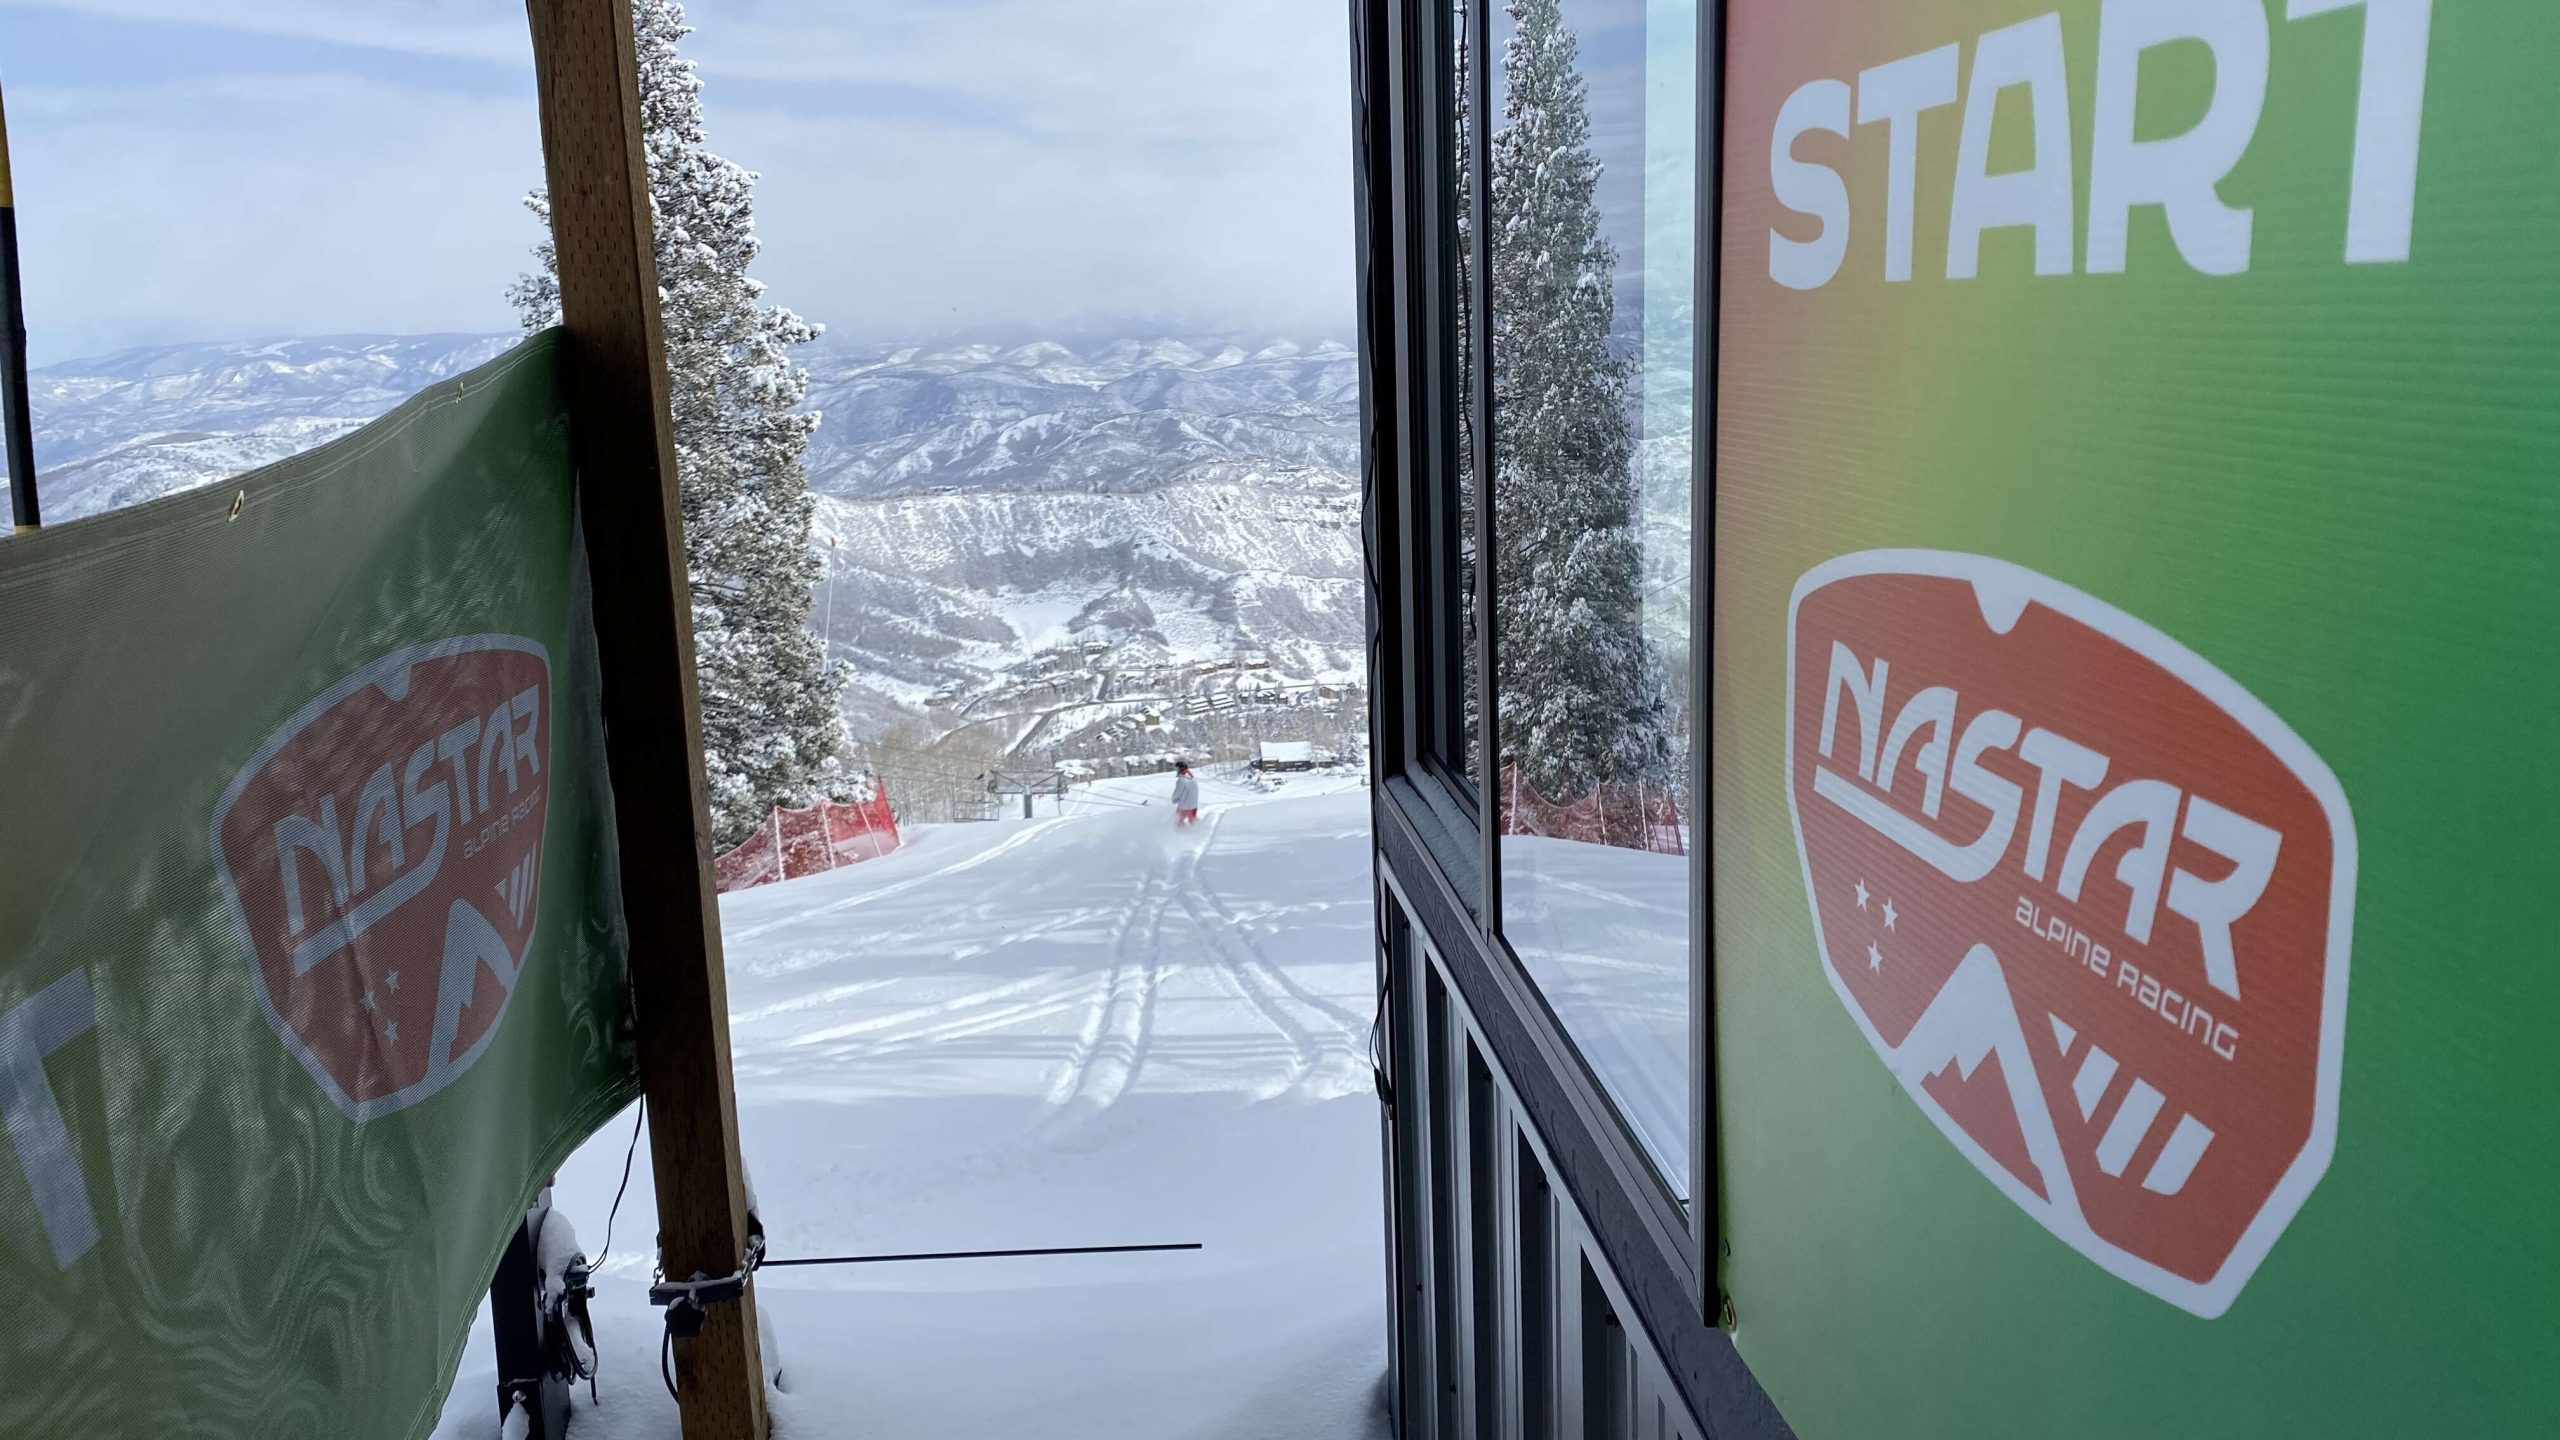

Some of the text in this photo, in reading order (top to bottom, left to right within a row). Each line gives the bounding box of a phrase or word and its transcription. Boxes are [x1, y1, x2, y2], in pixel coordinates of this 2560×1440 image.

[1768, 0, 2434, 290] START
[272, 683, 541, 978] NASTAR
[1813, 639, 2283, 1002] NASTAR
